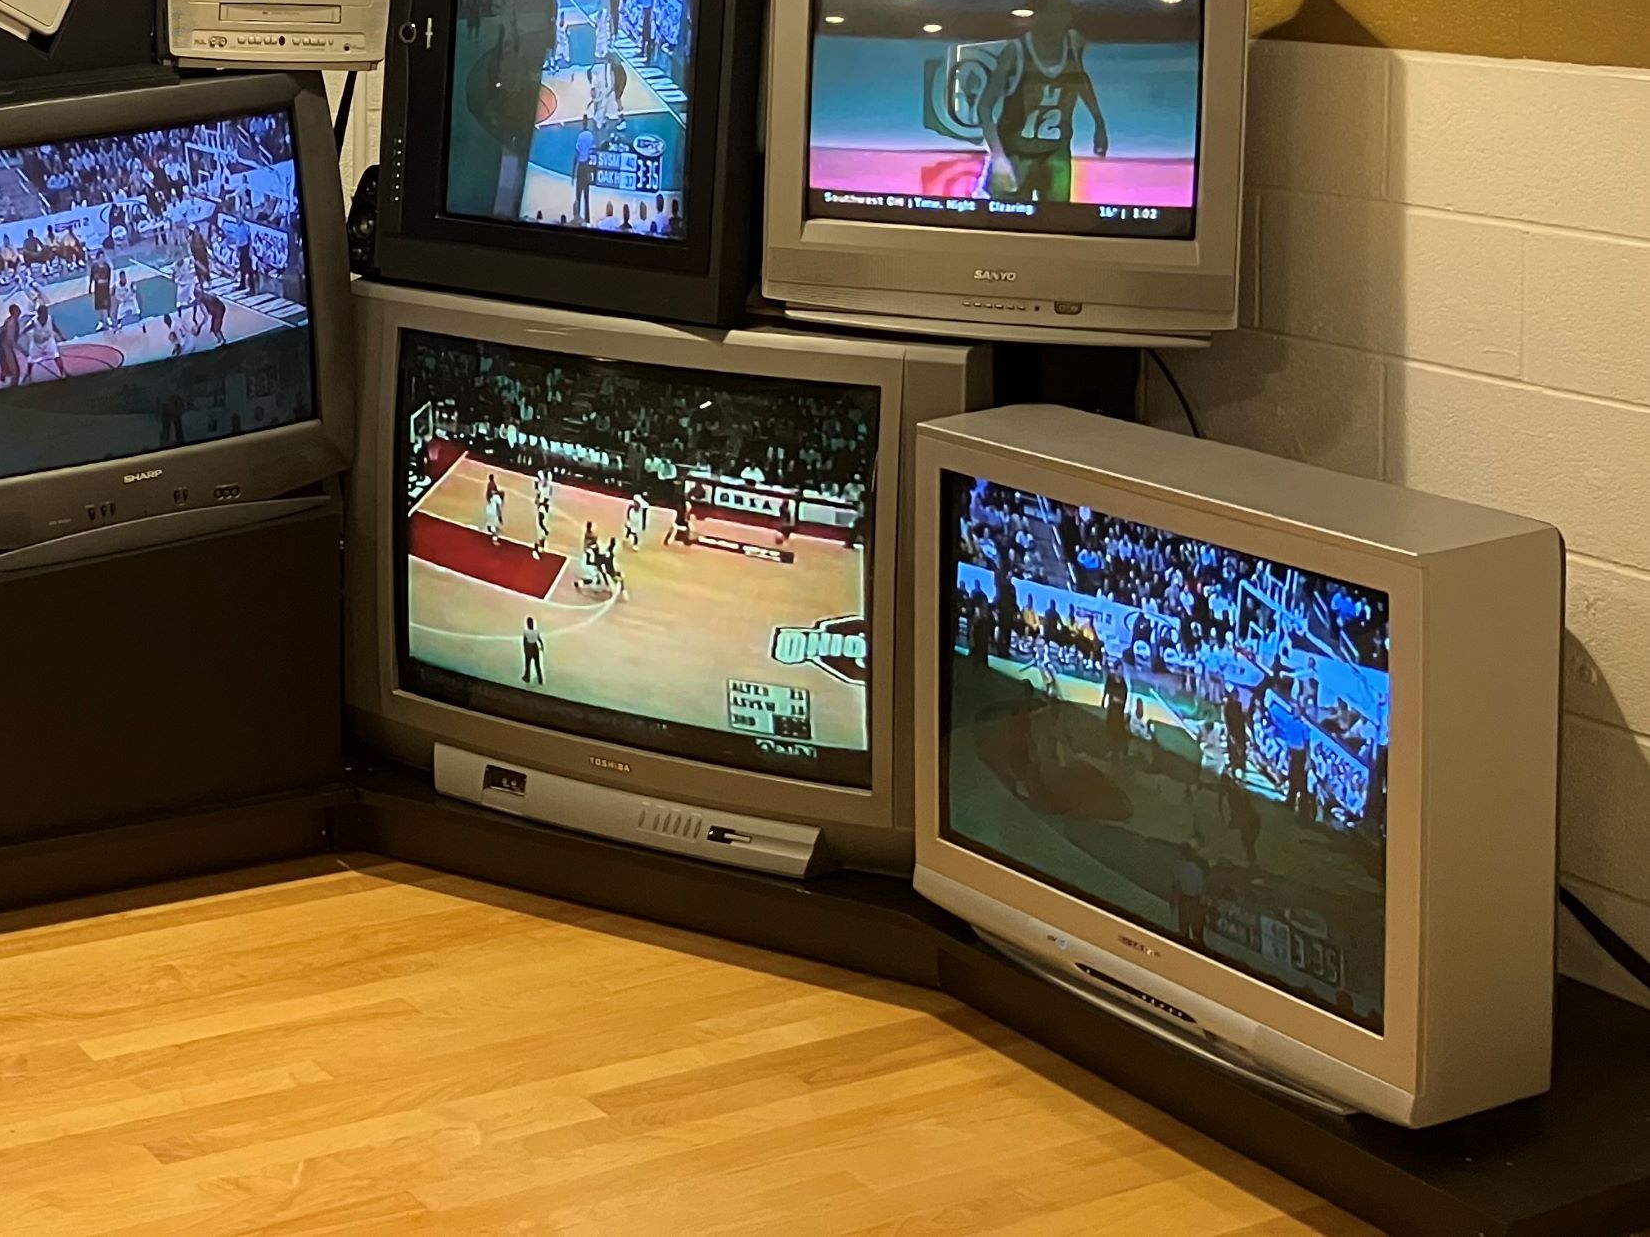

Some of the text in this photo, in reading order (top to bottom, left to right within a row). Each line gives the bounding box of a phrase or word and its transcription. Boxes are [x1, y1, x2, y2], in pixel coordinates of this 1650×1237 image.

[1020, 108, 1063, 140] 12
[972, 269, 1017, 283] SANYO
[122, 468, 163, 484] SHARP
[589, 756, 632, 773] TOSHIBA
